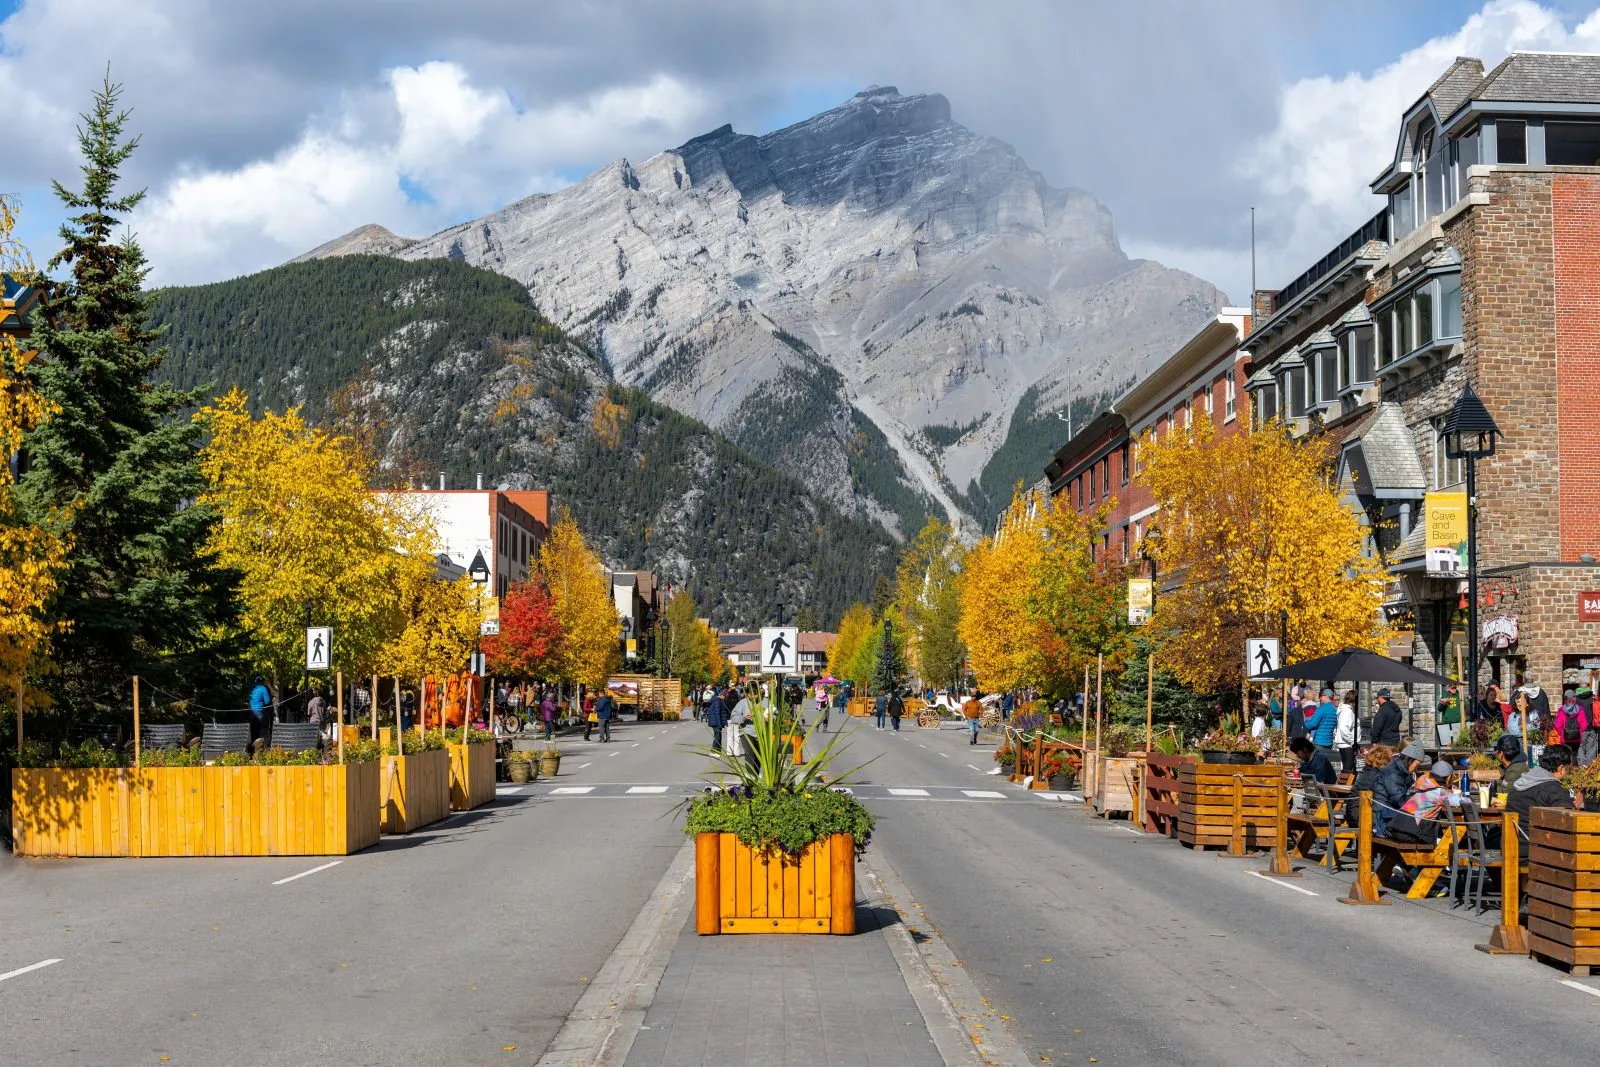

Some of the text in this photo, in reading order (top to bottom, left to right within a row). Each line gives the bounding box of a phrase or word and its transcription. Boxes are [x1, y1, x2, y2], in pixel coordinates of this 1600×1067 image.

[1431, 510, 1456, 521] Cave
[1432, 520, 1450, 530] and
[1432, 530, 1458, 540] Basin
